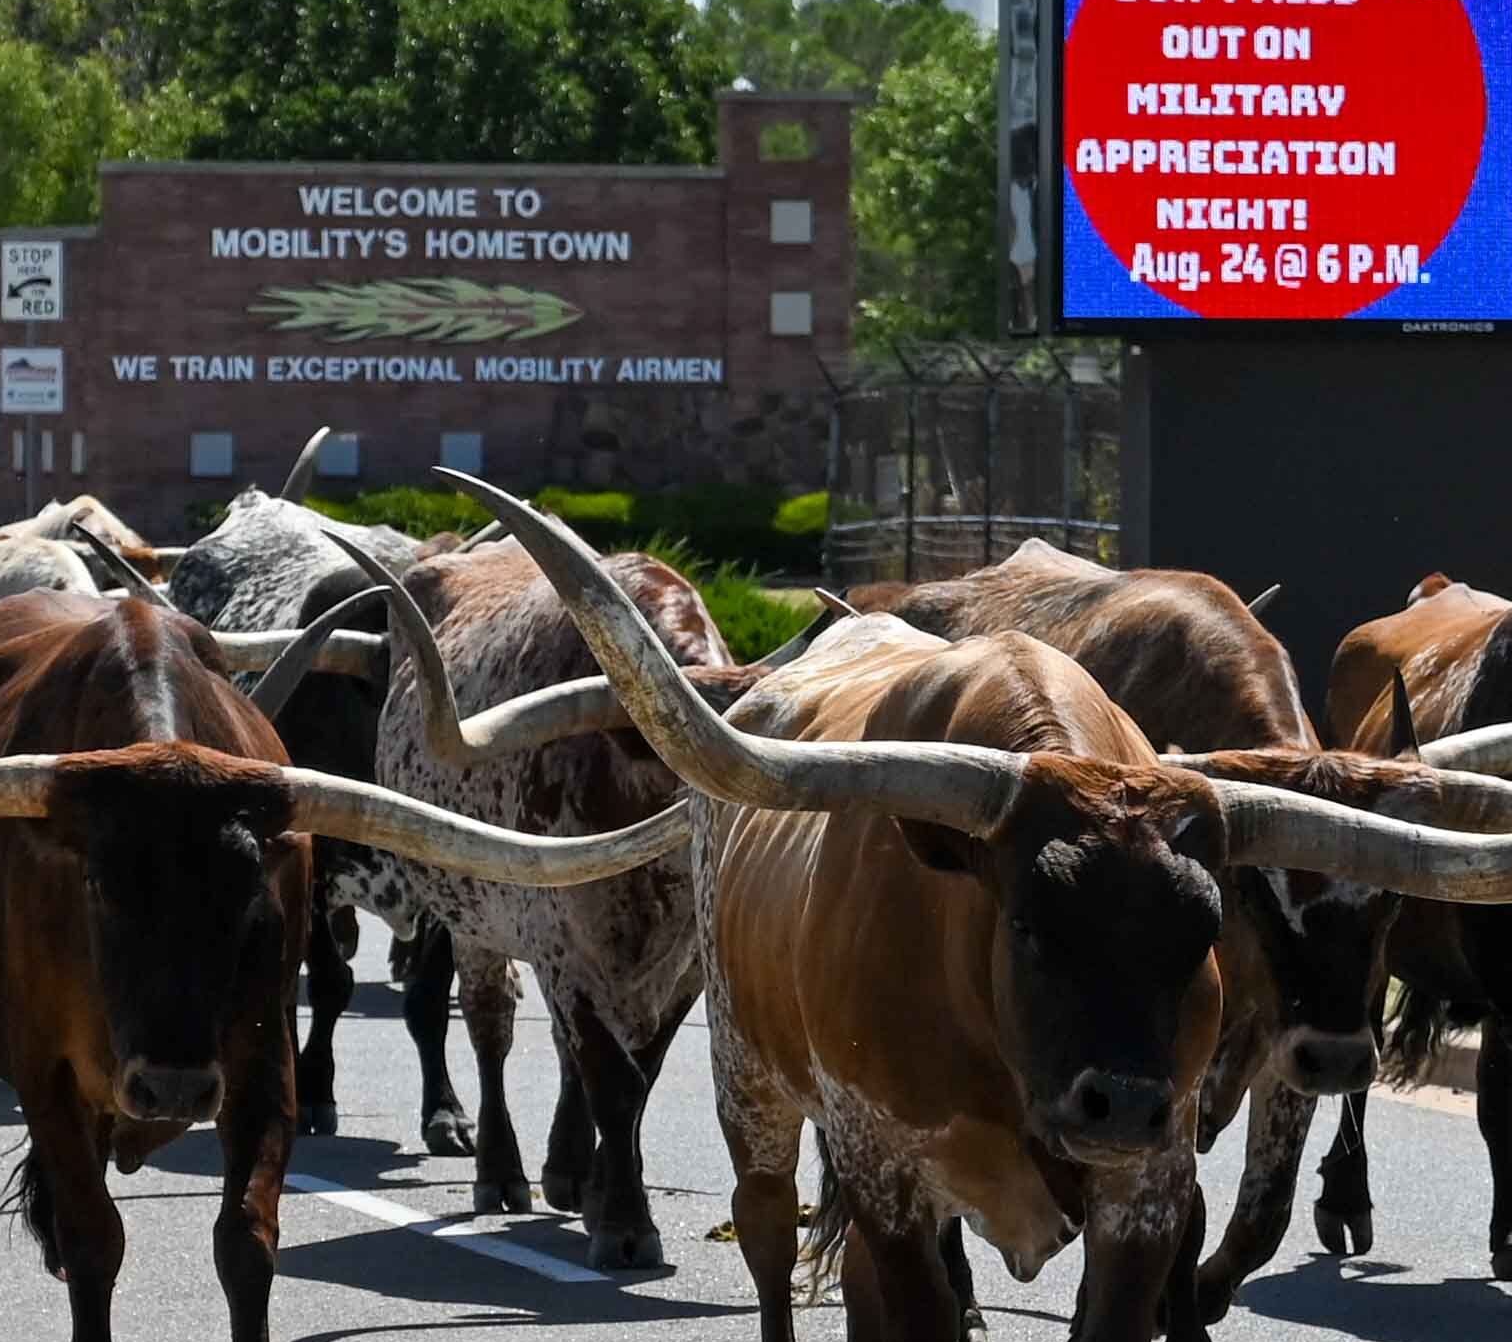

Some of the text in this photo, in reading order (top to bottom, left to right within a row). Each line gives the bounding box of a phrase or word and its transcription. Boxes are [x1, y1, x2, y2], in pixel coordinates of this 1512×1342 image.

[1163, 25, 1310, 59] OUT ON
[1128, 84, 1344, 115] MILITARY
[1077, 139, 1395, 175] APPRECIATION
[299, 187, 540, 217] WELCOME TO
[1157, 199, 1306, 230] NIGHT!
[10, 248, 52, 264] STOP
[213, 229, 628, 260] MOBILITY'S HOMETOWN
[1131, 243, 1431, 291] Aug. 24 @ 6 P.M.
[23, 300, 54, 315] RED
[113, 356, 720, 381] WE TRAIN EXCEPTIONAL MOBILITY AIRMEN
